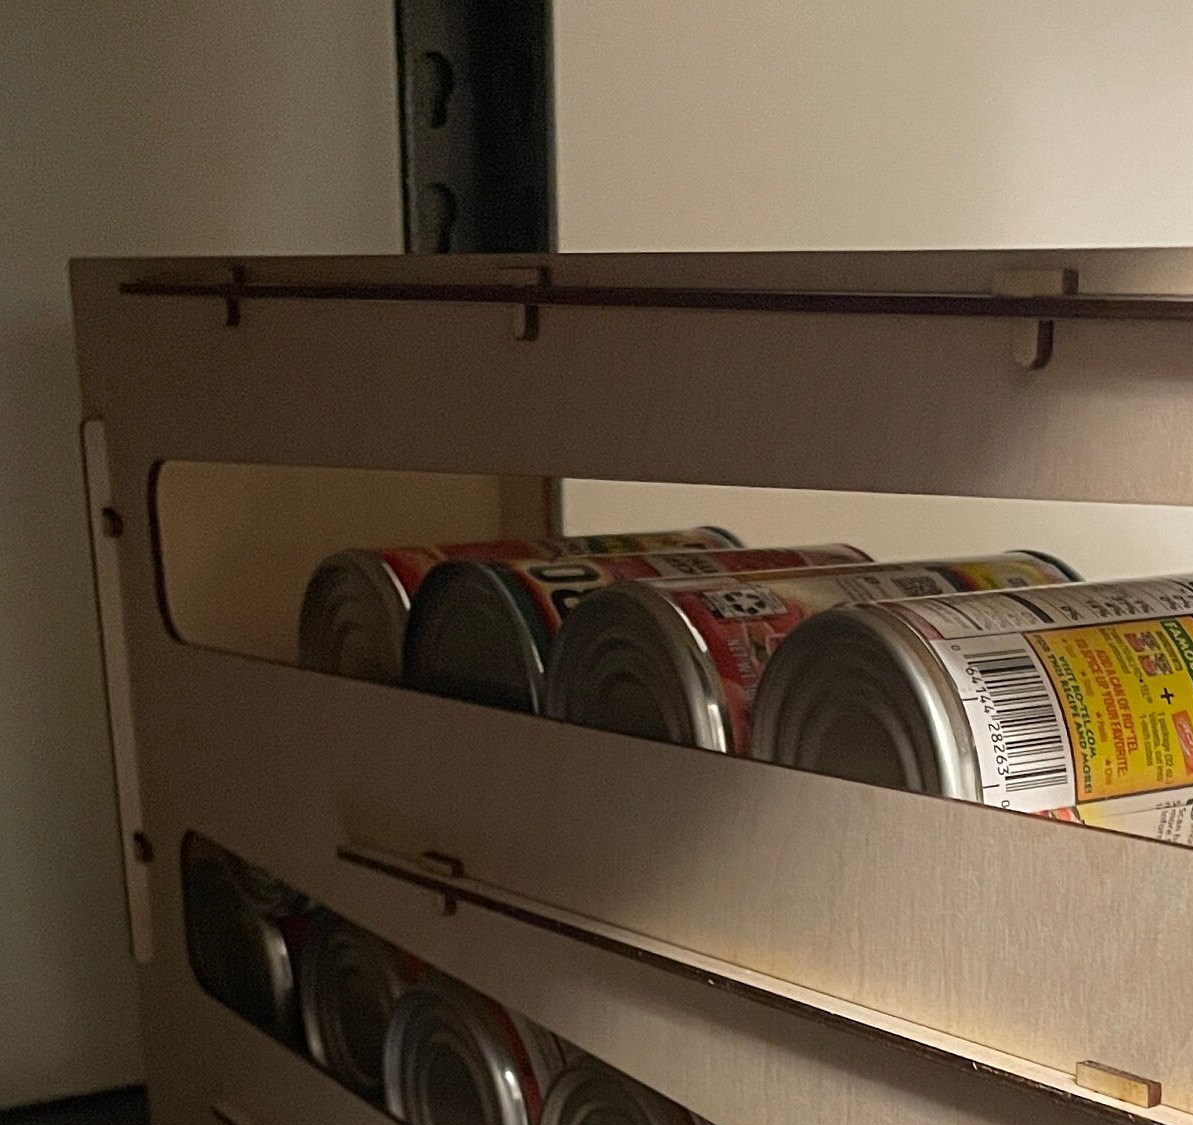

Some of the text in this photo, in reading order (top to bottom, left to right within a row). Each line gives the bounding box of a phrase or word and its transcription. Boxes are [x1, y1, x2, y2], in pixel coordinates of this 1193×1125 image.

[966, 667, 994, 714] 64144
[1096, 674, 1109, 690] UP
[1109, 676, 1123, 697] CAN
[1117, 698, 1128, 712] OF
[1061, 680, 1080, 718] RECIPE
[1075, 721, 1087, 750] AND
[1102, 691, 1118, 720] YOUR
[988, 722, 1010, 777] 28263
